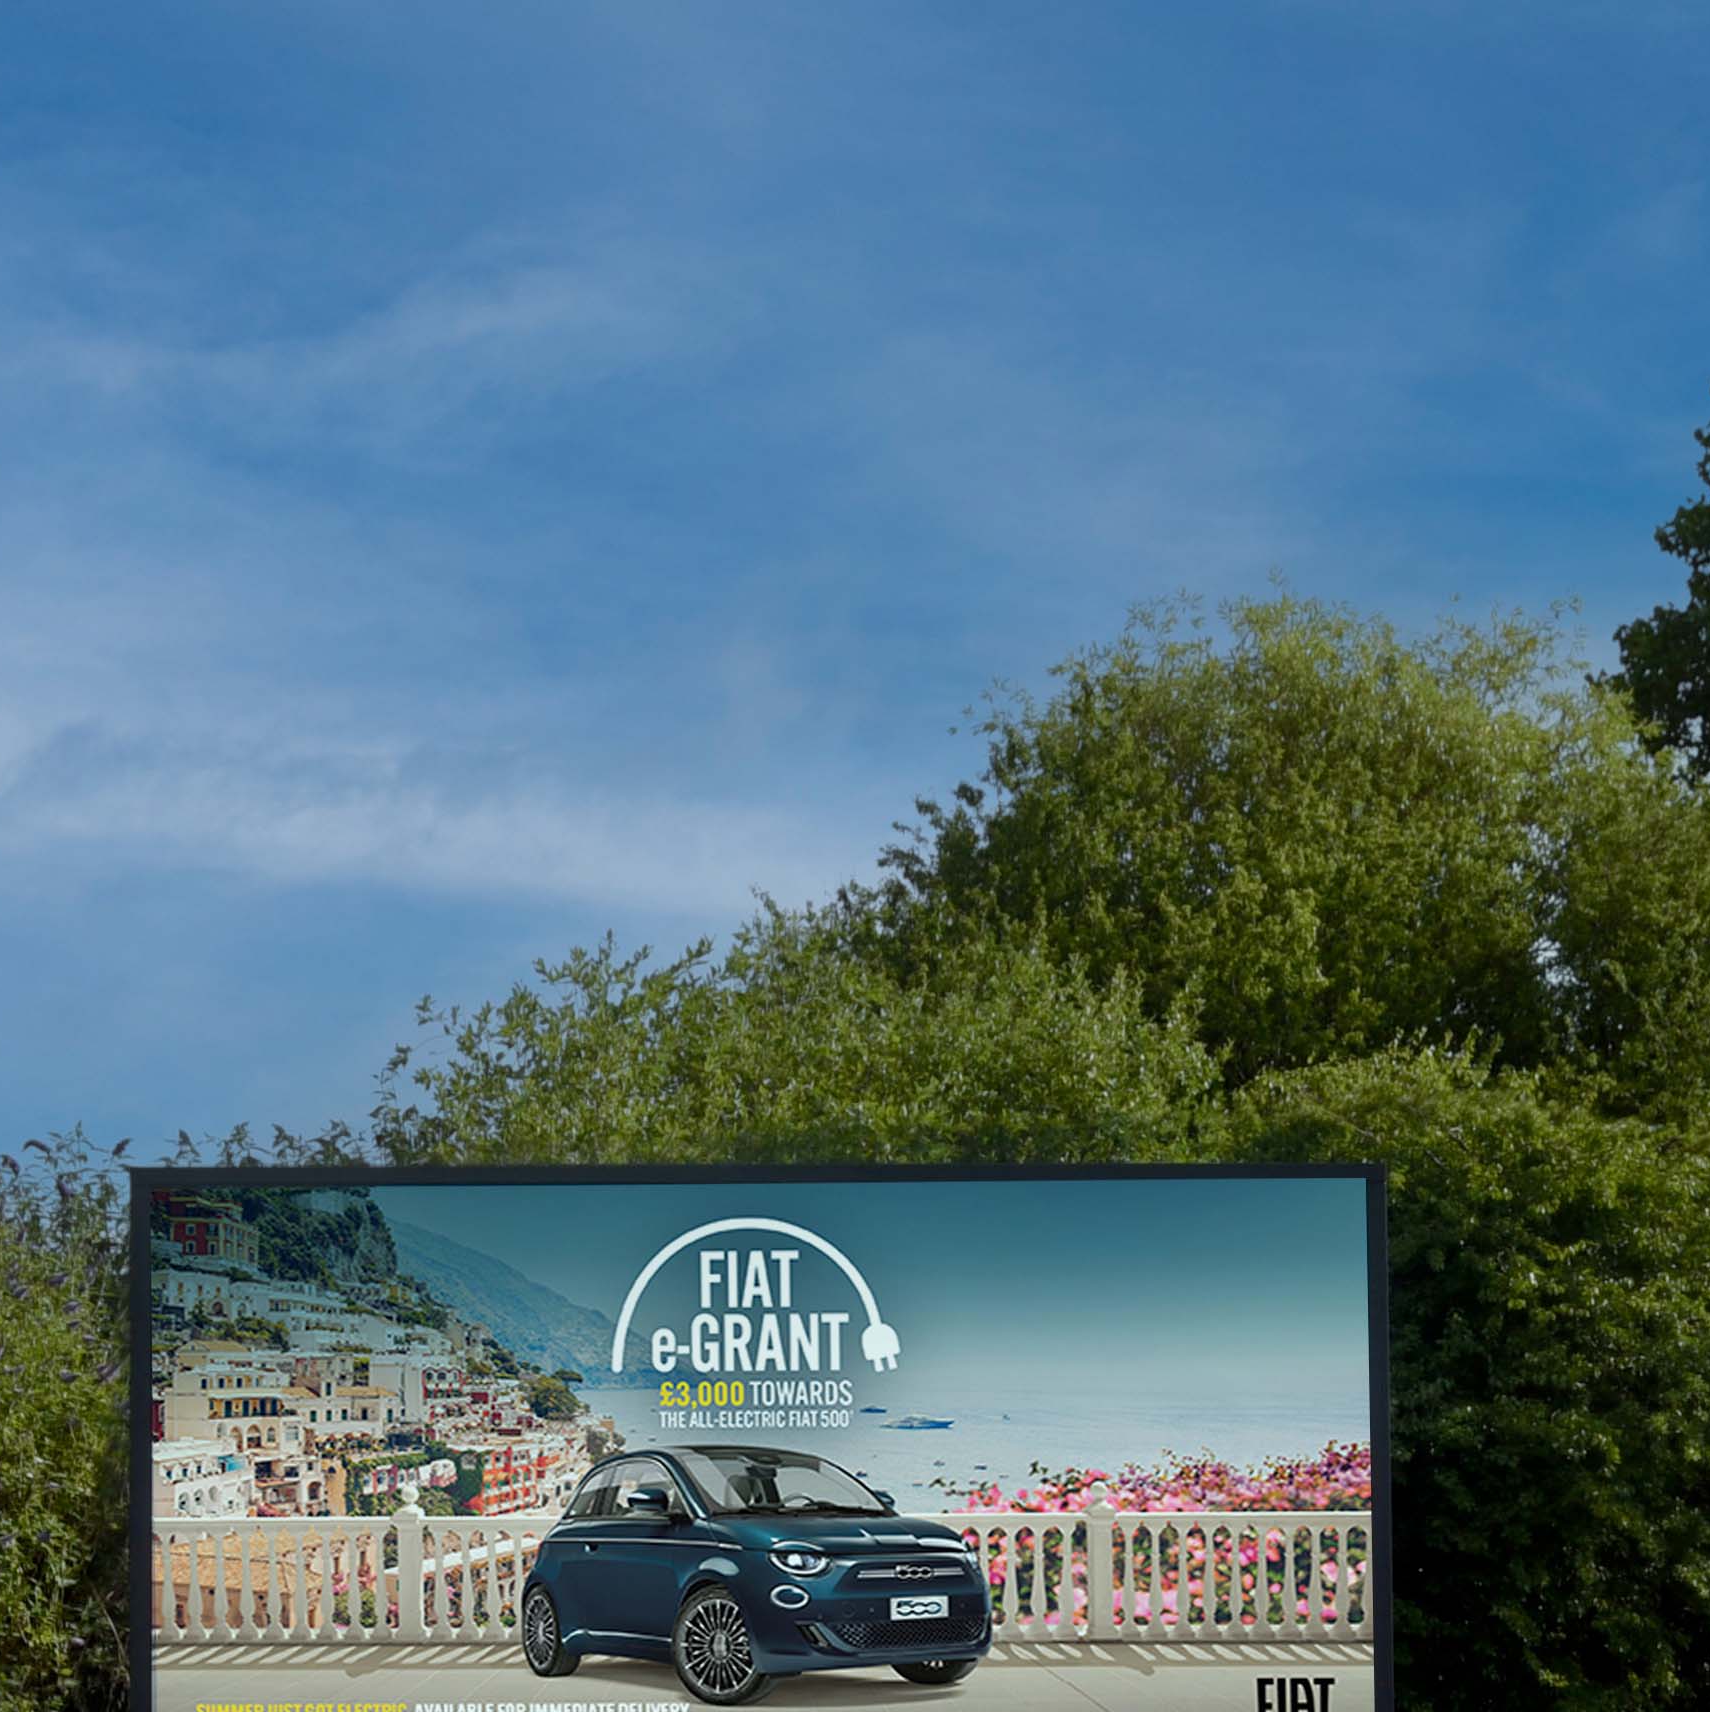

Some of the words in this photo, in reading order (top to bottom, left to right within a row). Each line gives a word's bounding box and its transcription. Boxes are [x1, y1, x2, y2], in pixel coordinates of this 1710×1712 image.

[700, 1250, 799, 1308] FIAT
[651, 1312, 850, 1373] e-GRANT
[659, 1381, 745, 1410] £3,000
[749, 1380, 853, 1406] TOWARDS
[660, 1411, 686, 1428] THE
[690, 1411, 786, 1428] ALL-ELECTRIC
[790, 1411, 818, 1427] FIAT
